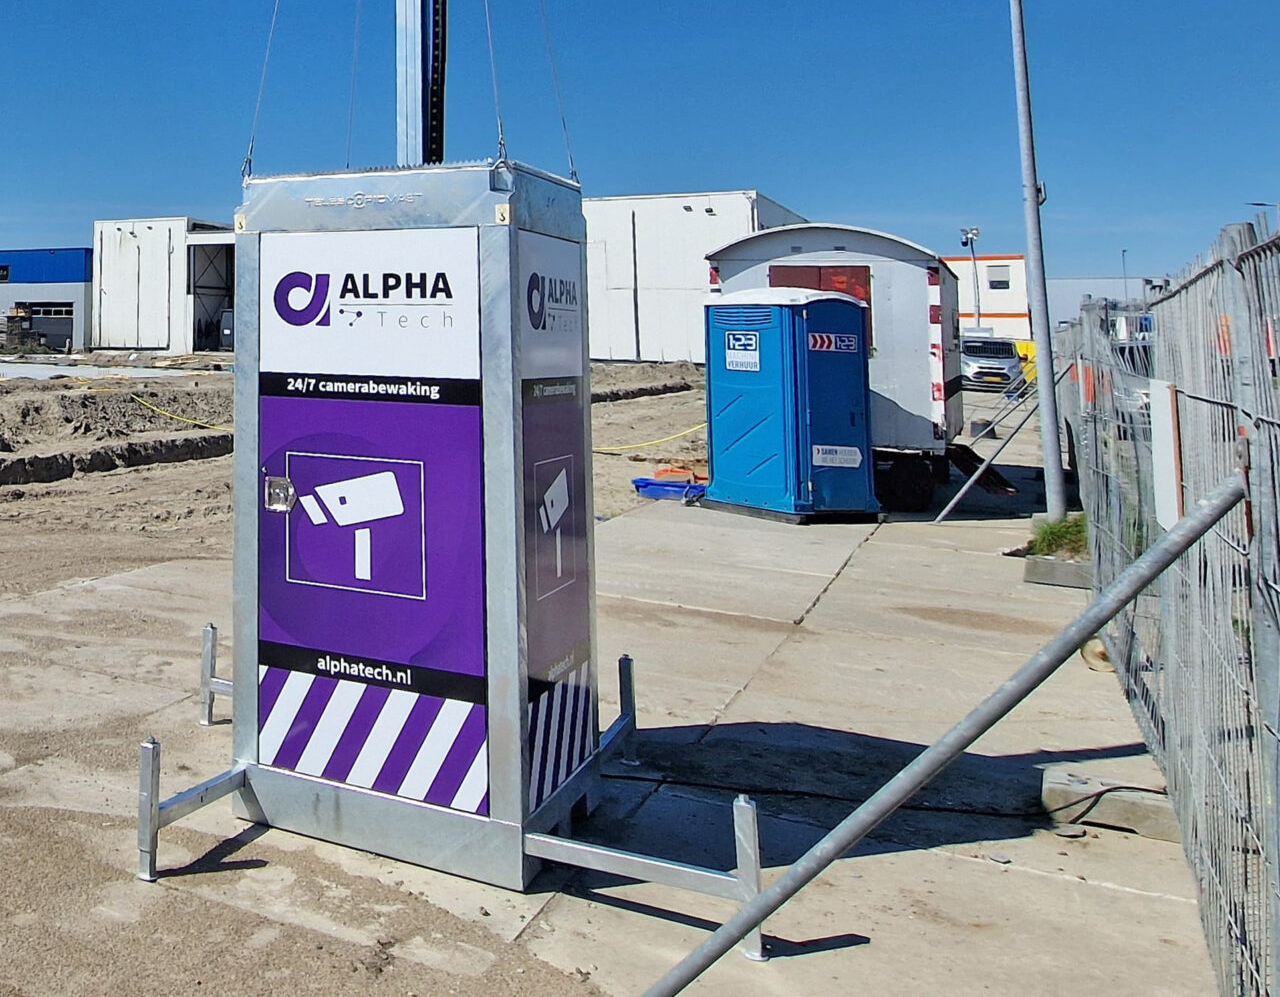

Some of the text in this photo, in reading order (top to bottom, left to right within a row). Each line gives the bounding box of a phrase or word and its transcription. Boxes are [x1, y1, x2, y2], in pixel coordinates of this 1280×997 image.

[339, 272, 453, 299] ALPHA
[547, 277, 578, 306] ALPHA
[377, 310, 453, 329] Tech
[286, 378, 441, 400] 24/7 camerabewaking
[317, 655, 412, 685] alphatech.nl
